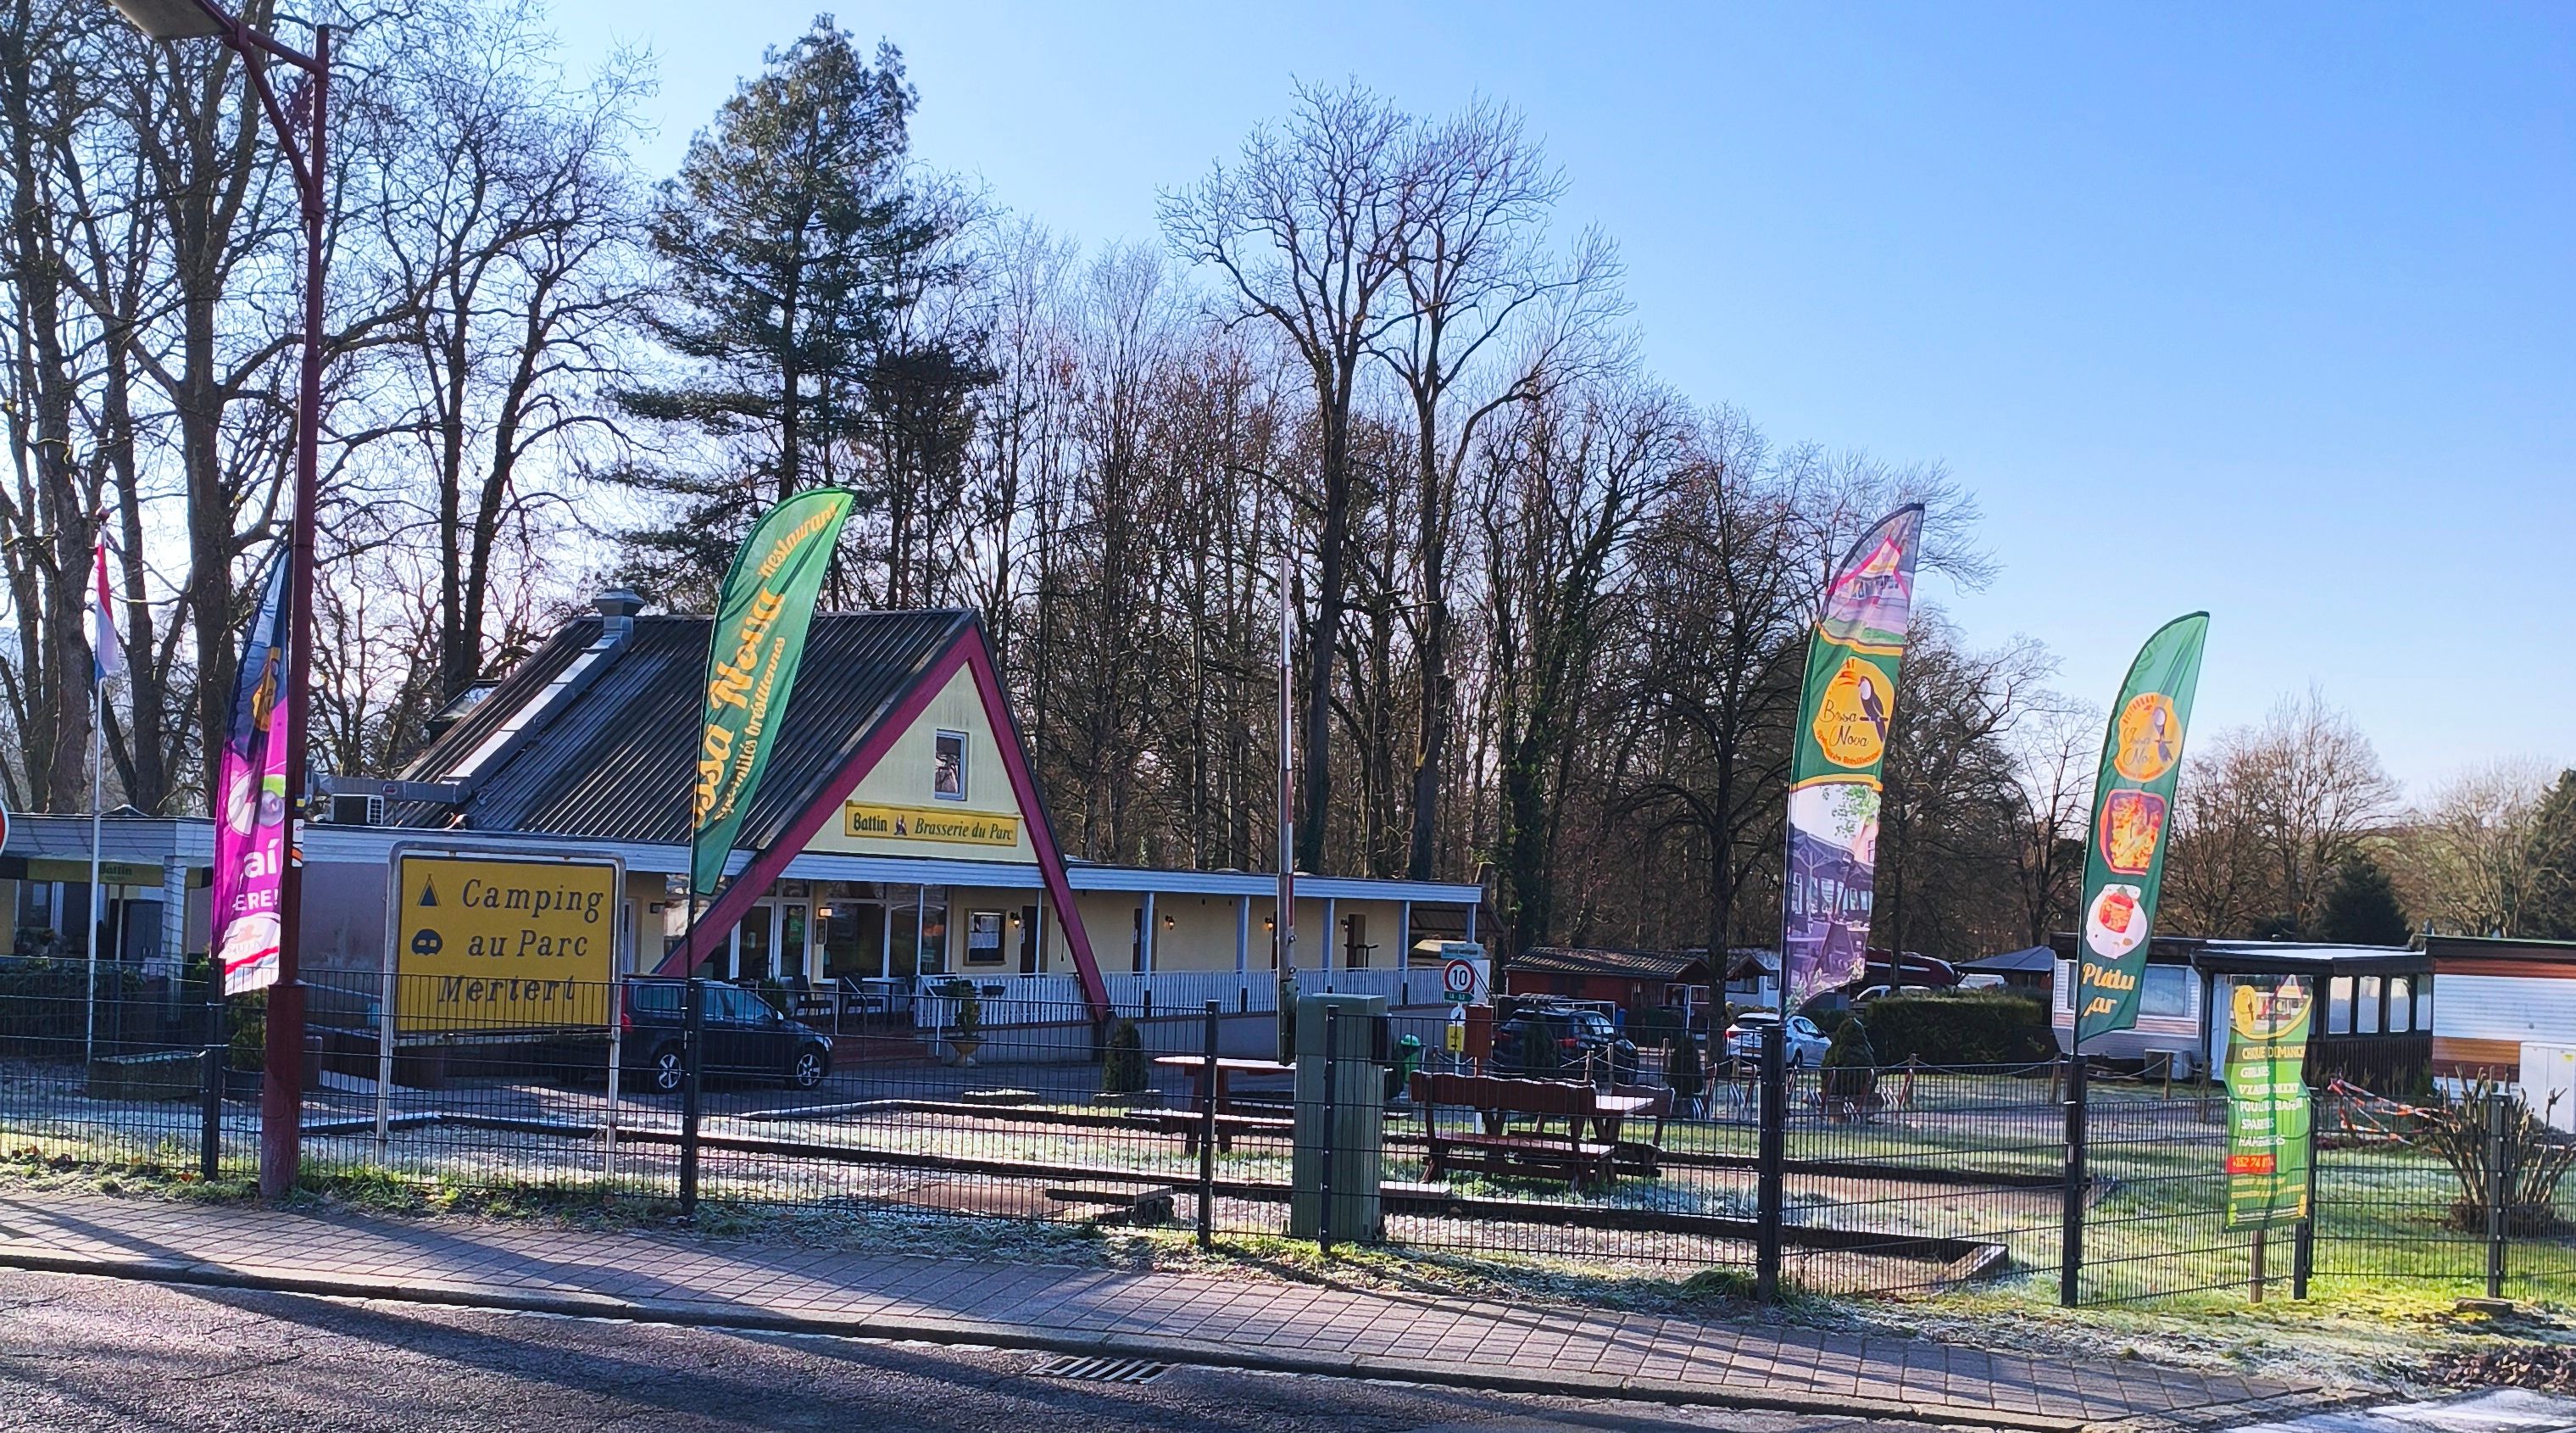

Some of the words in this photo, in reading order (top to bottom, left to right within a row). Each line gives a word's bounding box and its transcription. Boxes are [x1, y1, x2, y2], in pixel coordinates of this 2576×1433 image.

[1829, 726, 1869, 746] Nova
[854, 812, 887, 833] Battin
[915, 817, 970, 838] Brasserie
[971, 822, 986, 839] du
[989, 823, 1013, 839] Parc
[242, 838, 280, 880] aí
[233, 889, 278, 912] ERE!
[462, 878, 604, 923] Camping
[468, 935, 508, 956] au
[516, 930, 588, 957] Parc
[438, 975, 576, 1003] Mertert
[1453, 969, 1468, 986] 10
